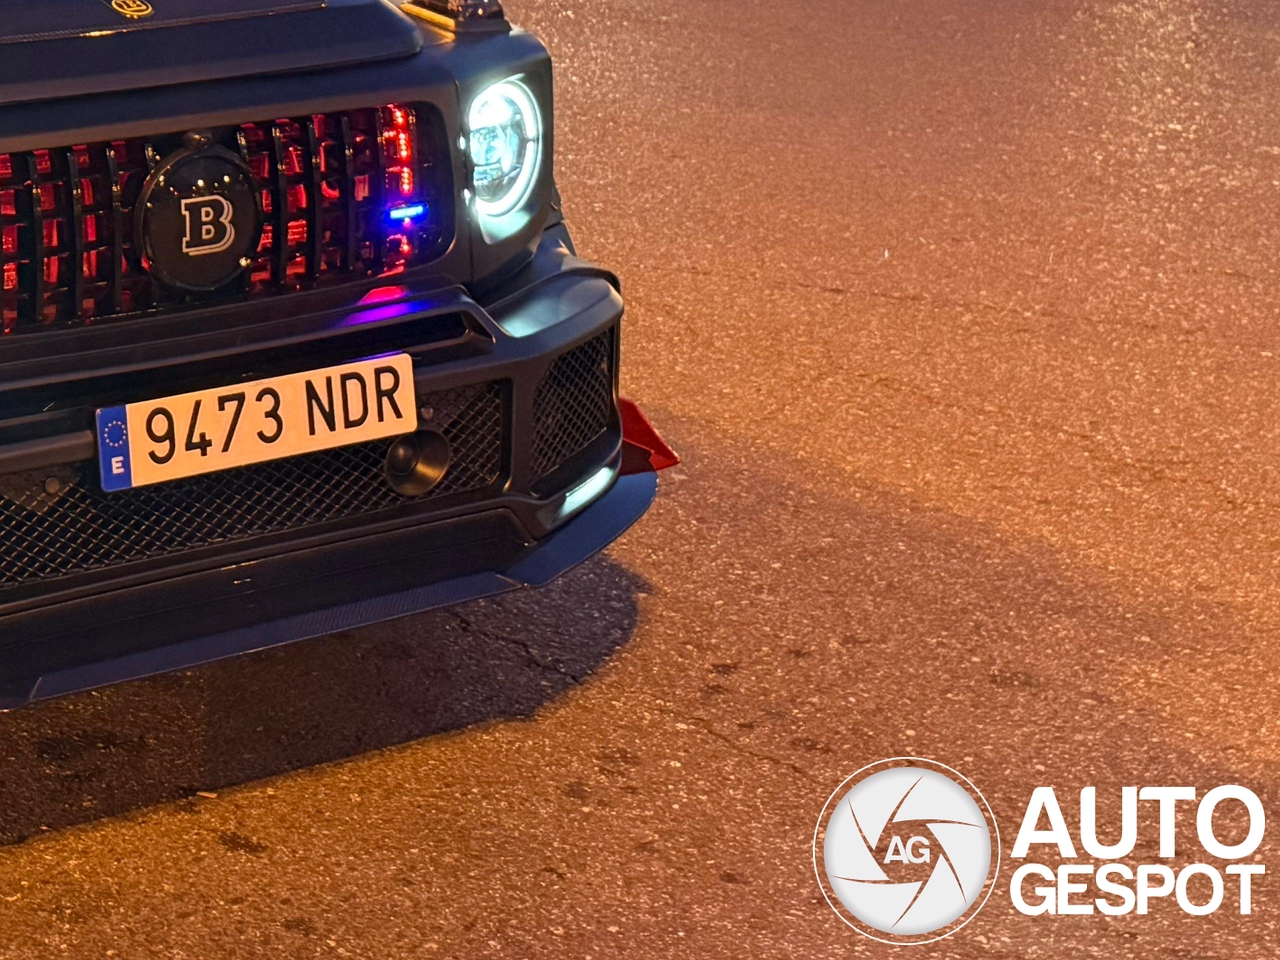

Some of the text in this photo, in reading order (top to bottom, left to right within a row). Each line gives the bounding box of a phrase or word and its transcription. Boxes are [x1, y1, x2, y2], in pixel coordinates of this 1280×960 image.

[181, 194, 236, 257] B
[145, 365, 403, 465] 9473 NDR
[111, 456, 125, 474] E
